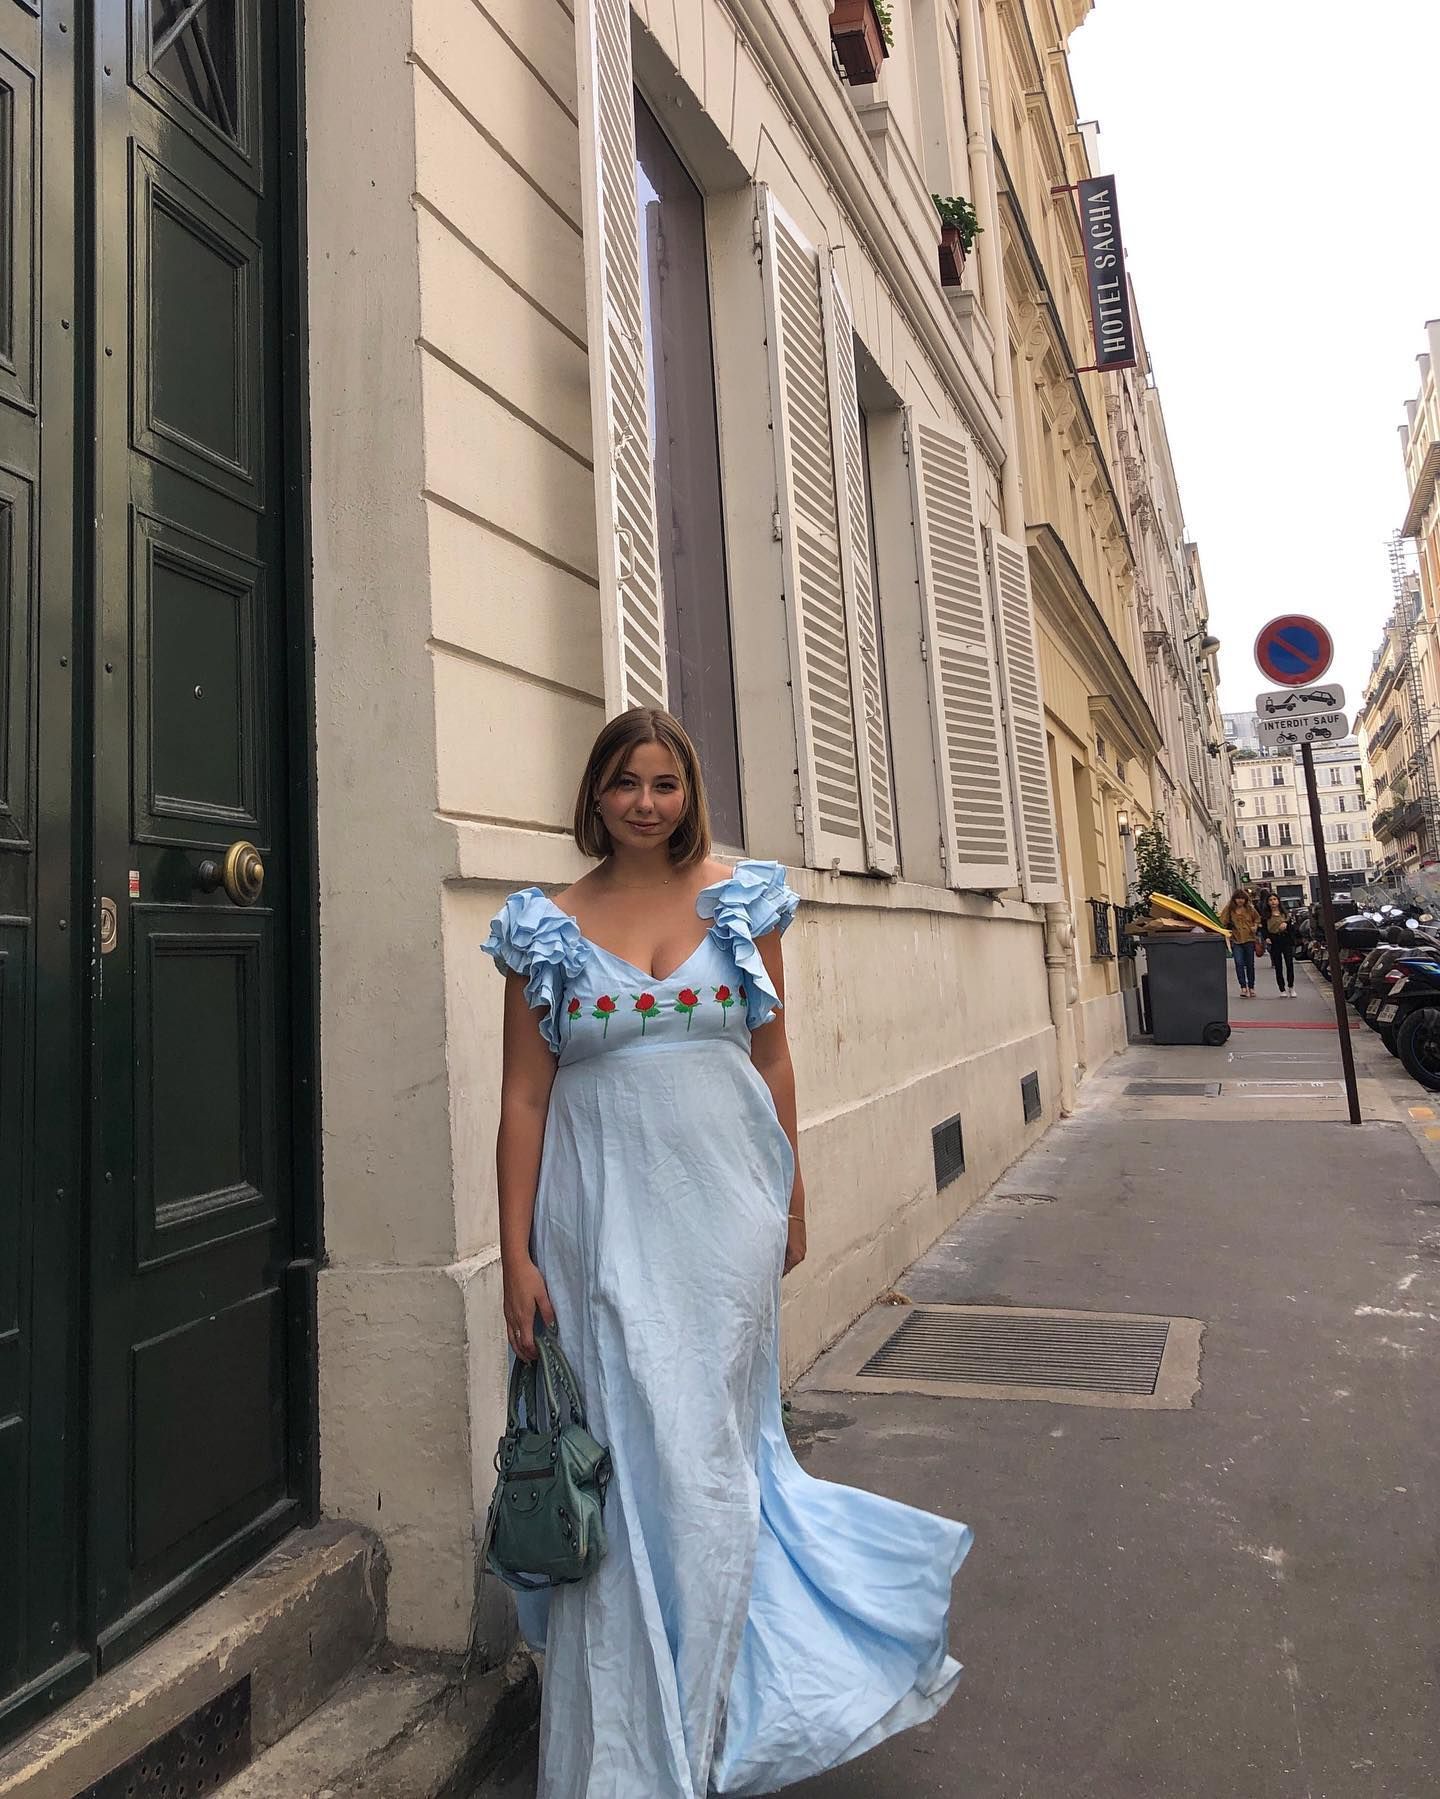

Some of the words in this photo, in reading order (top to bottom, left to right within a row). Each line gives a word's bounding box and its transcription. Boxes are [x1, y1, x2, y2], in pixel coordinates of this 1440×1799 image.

[1087, 189, 1117, 268] SACHA
[1097, 275, 1126, 353] HOTEL
[1264, 718, 1309, 730] INTERDIT
[1313, 714, 1340, 725] SAUF
